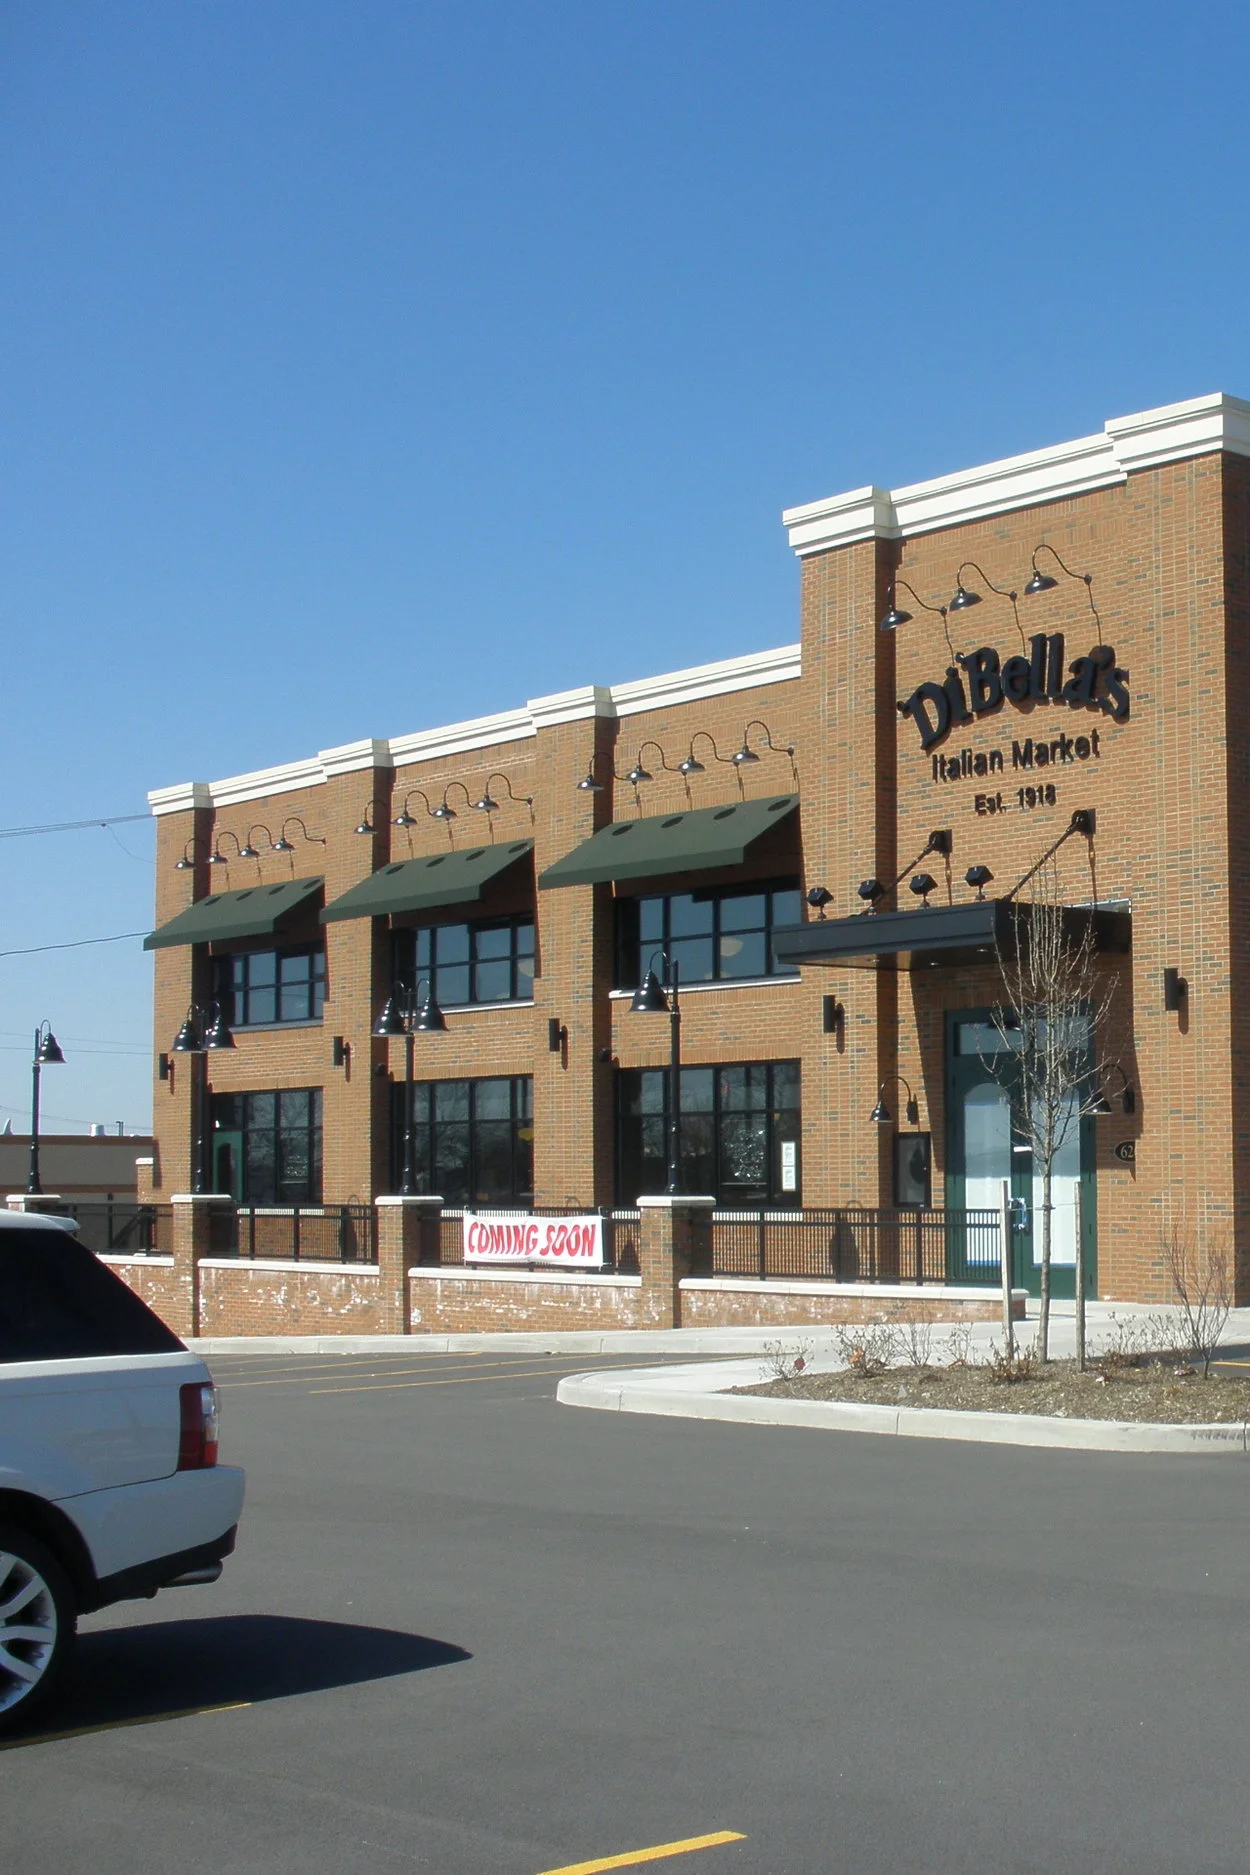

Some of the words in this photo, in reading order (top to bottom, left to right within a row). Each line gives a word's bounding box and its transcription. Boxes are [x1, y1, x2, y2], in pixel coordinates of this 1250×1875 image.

[897, 633, 1130, 754] DiBella's
[932, 748, 1003, 782] Italian
[1012, 728, 1100, 770] Market
[975, 792, 1006, 816] Est.
[1017, 784, 1056, 809] 1918
[468, 1221, 539, 1256] COMING
[540, 1224, 597, 1257] SOON
